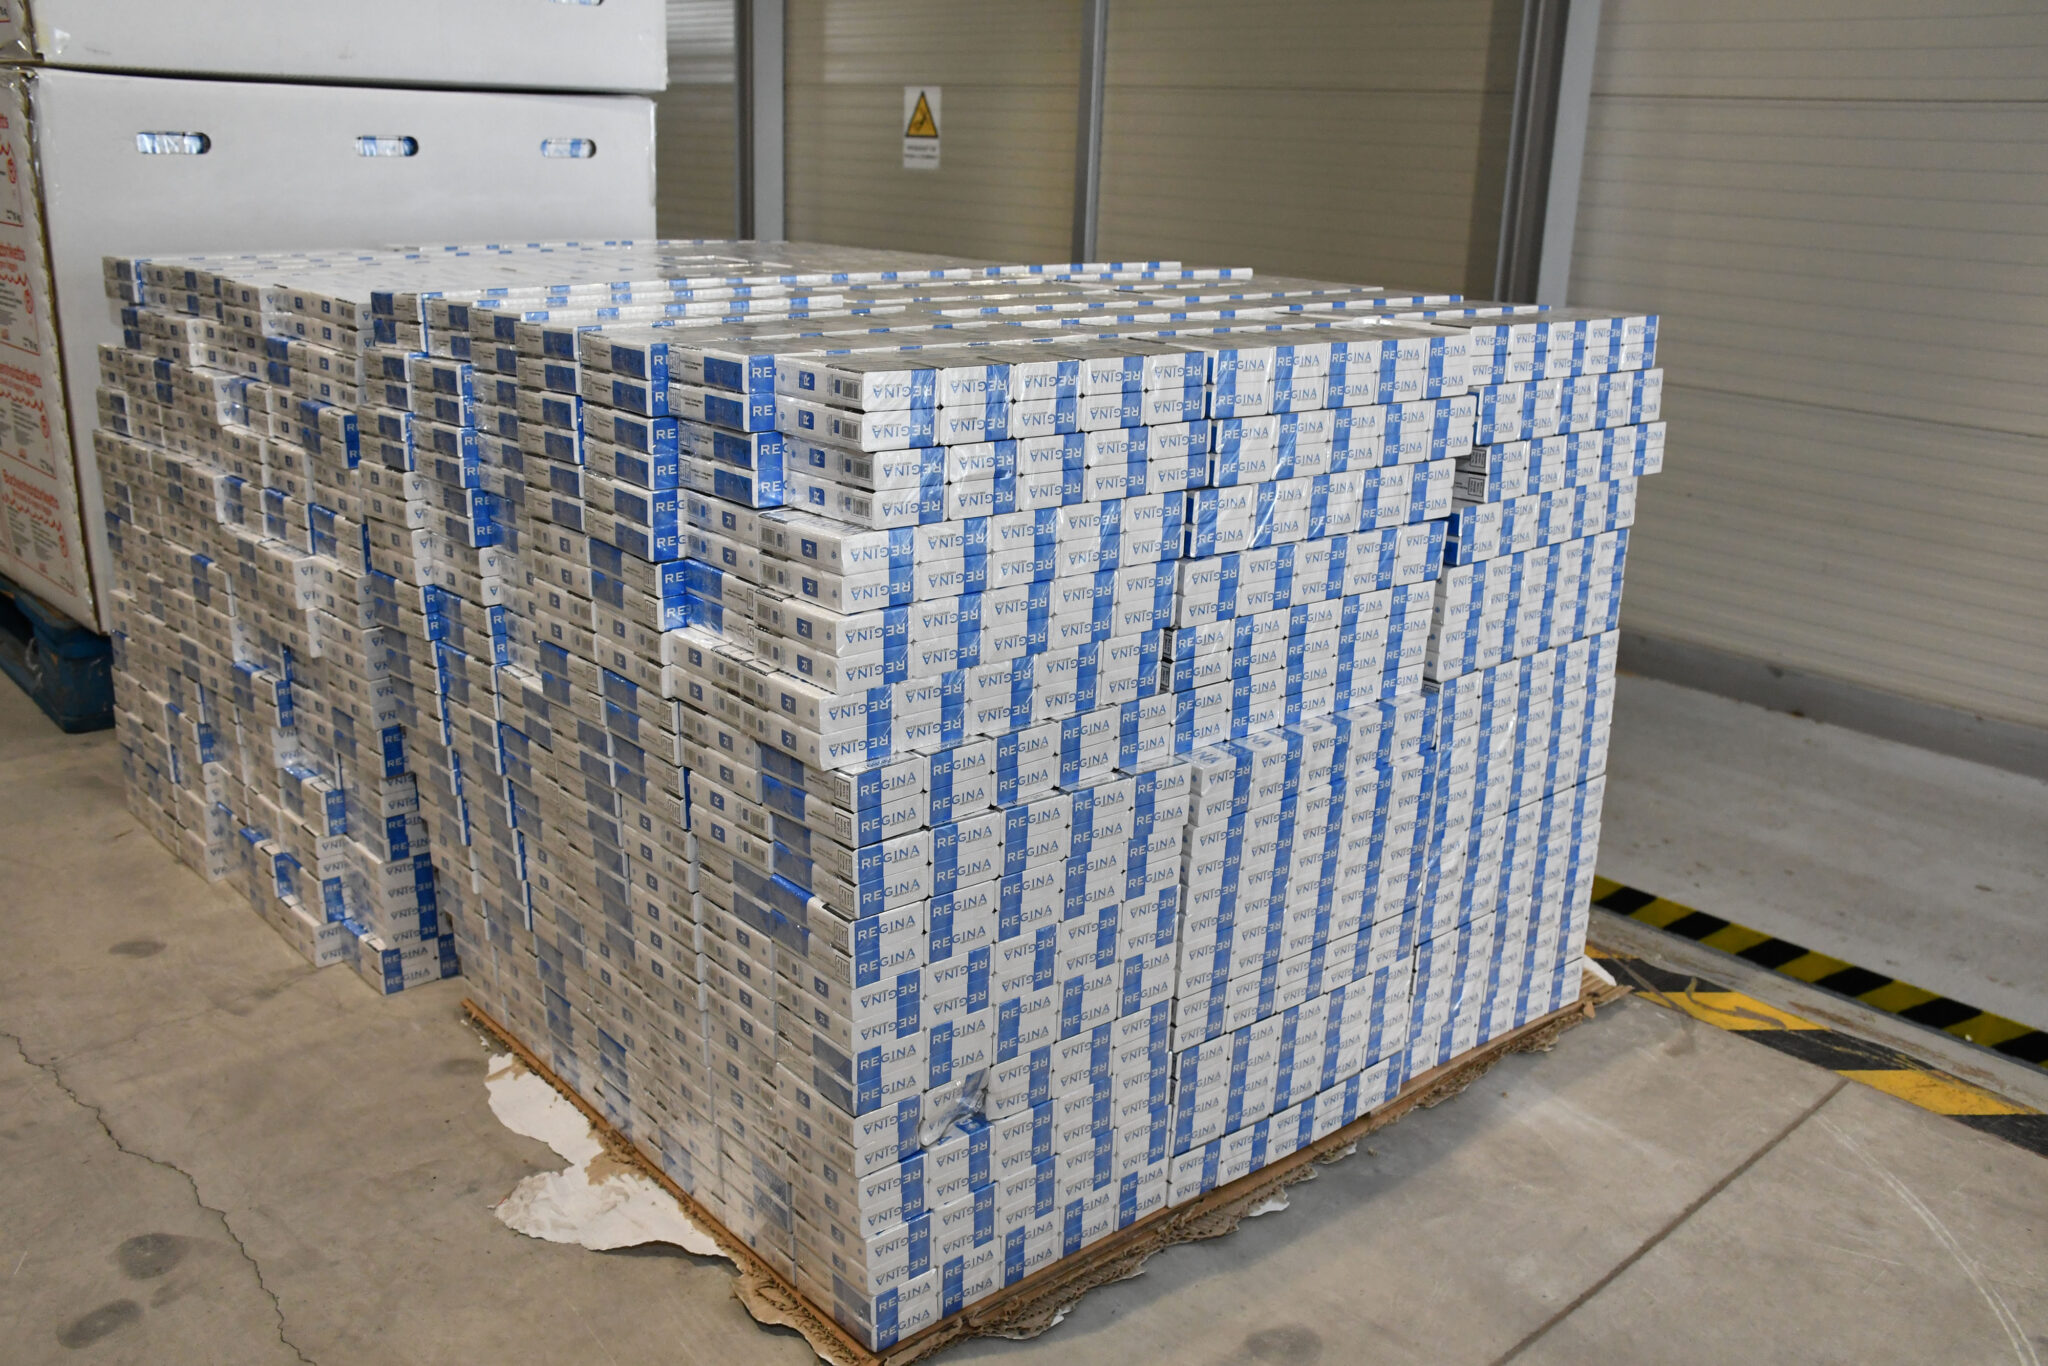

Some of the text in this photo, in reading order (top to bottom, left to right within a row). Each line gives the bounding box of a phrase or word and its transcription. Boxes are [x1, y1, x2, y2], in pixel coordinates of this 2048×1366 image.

[1332, 352, 1371, 363] REGINA
[1382, 350, 1420, 360] REGINA
[1431, 346, 1465, 356] REGINA
[1220, 359, 1265, 371] REGINA
[1277, 356, 1319, 367] REGINA
[951, 380, 1006, 393] REGINA
[1024, 375, 1075, 388] REGINA
[1380, 382, 1417, 392] REGINA
[1429, 375, 1464, 387] REGINA
[1275, 390, 1317, 400] REGINA
[1329, 386, 1369, 396] REGINA
[1218, 394, 1263, 406] REGINA
[1022, 412, 1074, 426] REGINA
[1387, 412, 1424, 422] REGINA
[1437, 407, 1472, 417] REGINA
[872, 424, 932, 438] REGINA
[950, 418, 1005, 431] REGINA
[1336, 418, 1375, 428] REGINA
[1160, 434, 1206, 448] REGINA
[1224, 428, 1269, 439] REGINA
[1433, 436, 1469, 448] REGINA
[1030, 448, 1082, 463] REGINA
[1097, 441, 1146, 456] REGINA
[1333, 449, 1372, 460] REGINA
[1386, 442, 1422, 453] REGINA
[1158, 468, 1204, 482] REGINA
[1222, 461, 1266, 472] REGINA
[1096, 475, 1145, 491] REGINA
[1366, 478, 1402, 488] REGINA
[1415, 470, 1450, 481] REGINA
[1029, 484, 1081, 499] REGINA
[1314, 484, 1353, 494] REGINA
[958, 491, 1013, 507] REGINA
[1412, 499, 1447, 510] REGINA
[882, 500, 940, 517] REGINA
[1134, 505, 1180, 521] REGINA
[1364, 506, 1399, 517] REGINA
[1002, 524, 1054, 540] REGINA
[929, 532, 984, 550] REGINA
[1133, 540, 1178, 554] REGINA
[1358, 541, 1394, 555] REGINA
[851, 544, 910, 562] REGINA
[1069, 549, 1117, 565] REGINA
[1307, 550, 1345, 563] REGINA
[1001, 560, 1053, 576] REGINA
[1250, 558, 1292, 573] REGINA
[929, 570, 984, 588] REGINA
[1126, 576, 1172, 591] REGINA
[1192, 569, 1237, 584] REGINA
[851, 582, 910, 600] REGINA
[1063, 587, 1112, 602] REGINA
[1247, 590, 1289, 604] REGINA
[1124, 608, 1170, 624] REGINA
[1189, 601, 1234, 616] REGINA
[1344, 601, 1381, 615] REGINA
[923, 610, 978, 628] REGINA
[1291, 611, 1331, 625] REGINA
[846, 626, 906, 644] REGINA
[1061, 621, 1109, 637] REGINA
[1237, 621, 1278, 636] REGINA
[1179, 632, 1223, 648] REGINA
[1289, 640, 1329, 655] REGINA
[922, 648, 979, 665] REGINA
[1112, 643, 1156, 659] REGINA
[1235, 652, 1276, 667] REGINA
[1047, 657, 1096, 672] REGINA
[1177, 665, 1221, 679] REGINA
[1109, 676, 1154, 692] REGINA
[906, 686, 963, 704] REGINA
[1178, 694, 1223, 711] REGINA
[830, 702, 890, 720] REGINA
[1123, 704, 1166, 724] REGINA
[1064, 720, 1110, 740] REGINA
[1000, 736, 1049, 758] REGINA
[1121, 737, 1166, 755] REGINA
[933, 753, 985, 776] REGINA
[1062, 754, 1110, 772] REGINA
[860, 772, 916, 796] REGINA
[1000, 769, 1049, 792] REGINA
[1208, 765, 1250, 786] REGINA
[1138, 776, 1185, 794] REGINA
[933, 788, 985, 811] REGINA
[1075, 791, 1124, 812] REGINA
[861, 808, 916, 832] REGINA
[1008, 808, 1061, 830] REGINA
[1136, 808, 1184, 825] REGINA
[1255, 808, 1294, 829] REGINA
[937, 825, 992, 848] REGINA
[1074, 823, 1123, 844] REGINA
[1200, 826, 1242, 846] REGINA
[1007, 841, 1059, 863] REGINA
[1130, 838, 1176, 857] REGINA
[861, 846, 920, 869] REGINA
[936, 860, 992, 882] REGINA
[1068, 856, 1117, 877] REGINA
[1128, 868, 1174, 888] REGINA
[864, 880, 919, 903] REGINA
[932, 894, 988, 918] REGINA
[1130, 896, 1176, 918] REGINA
[1244, 893, 1284, 914] REGINA
[858, 916, 914, 941] REGINA
[1068, 916, 1118, 938] REGINA
[1004, 937, 1057, 959] REGINA
[1188, 940, 1230, 960] REGINA
[934, 958, 988, 984] REGINA
[1126, 953, 1170, 976] REGINA
[1066, 974, 1113, 998] REGINA
[860, 982, 918, 1008] REGINA
[1001, 996, 1051, 1020] REGINA
[1122, 1014, 1168, 1033] REGINA
[1061, 1037, 1111, 1056] REGINA
[1229, 1102, 1265, 1124] REGINA
[1002, 1113, 1050, 1139] REGINA
[1178, 1124, 1216, 1144] REGINA
[936, 1140, 988, 1166] REGINA
[1123, 1145, 1166, 1169] REGINA
[866, 1169, 921, 1197] REGINA
[1007, 1169, 1051, 1195] REGINA
[1176, 1175, 1215, 1198] REGINA
[1006, 1198, 1055, 1223] REGINA
[1121, 1194, 1162, 1218] REGINA
[875, 1228, 927, 1256] REGINA
[1065, 1221, 1108, 1246] REGINA
[1007, 1249, 1053, 1275] REGINA
[945, 1276, 992, 1306] REGINA
[879, 1309, 930, 1339] REGINA
